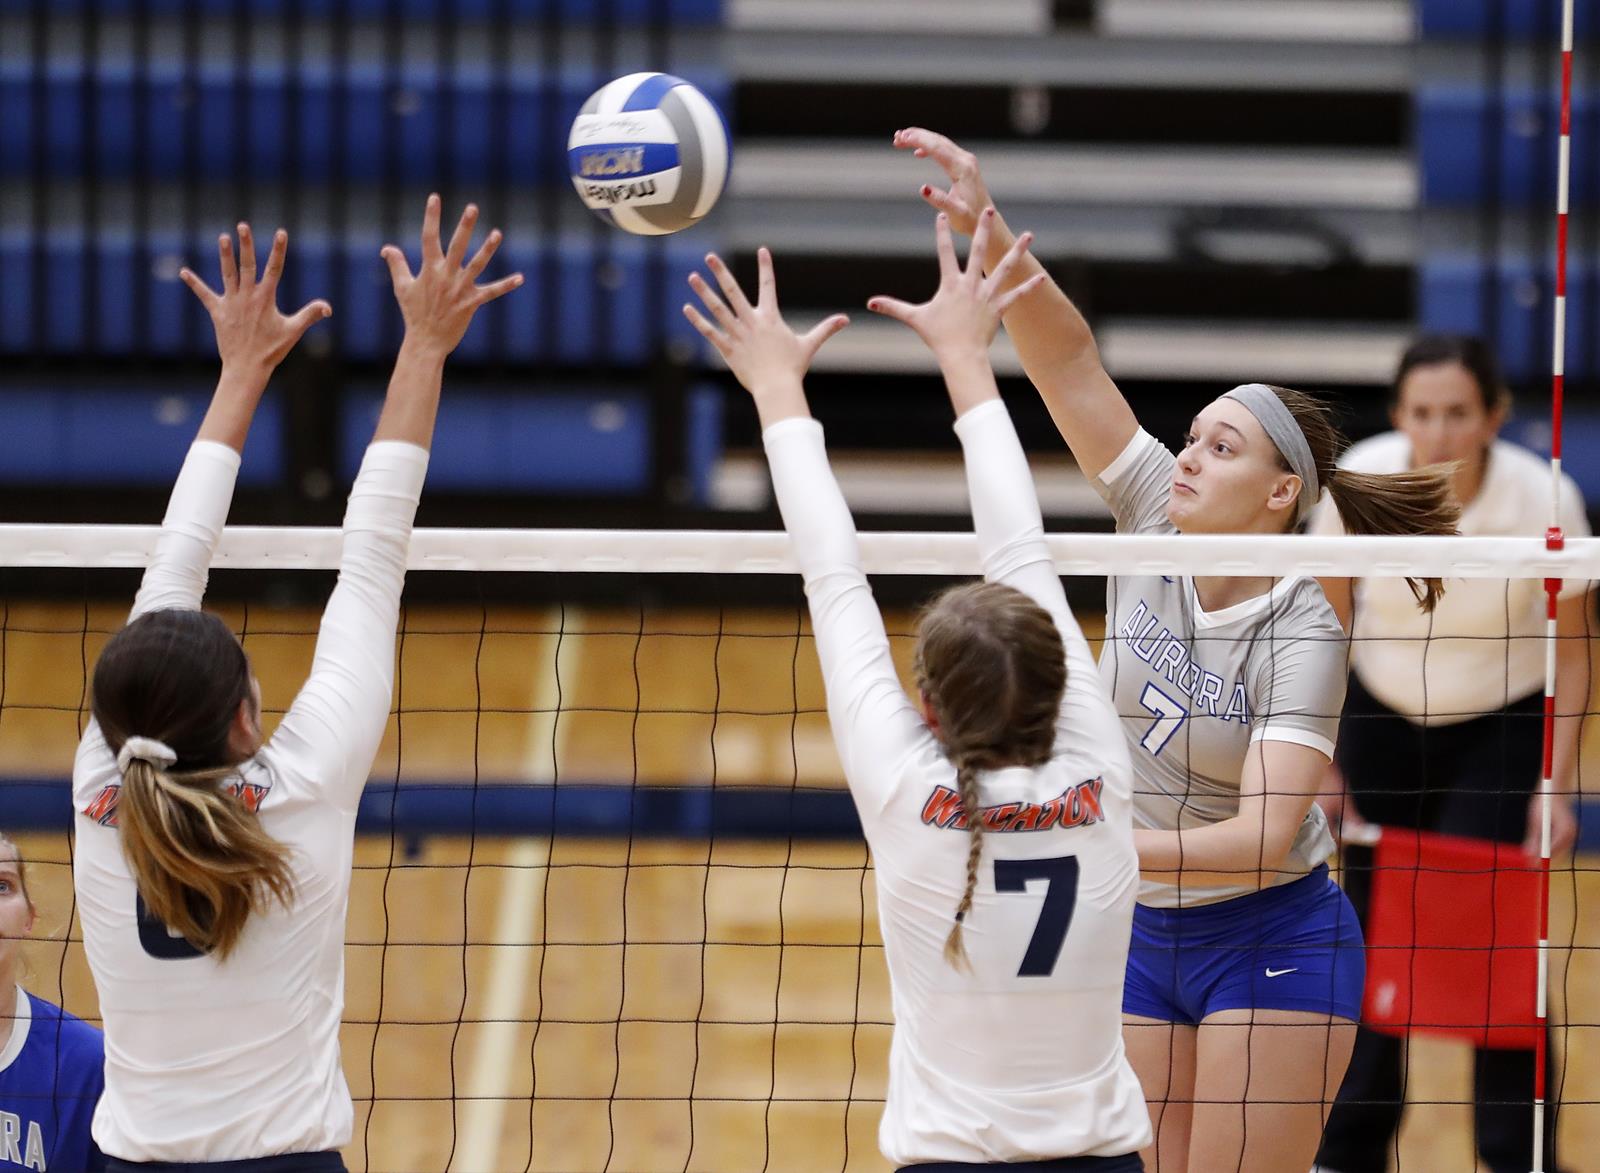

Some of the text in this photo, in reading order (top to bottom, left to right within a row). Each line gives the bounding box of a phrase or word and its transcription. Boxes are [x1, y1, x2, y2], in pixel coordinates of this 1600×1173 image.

[1121, 599, 1249, 725] AURORA
[1139, 680, 1189, 757] 7
[993, 855, 1080, 977] 7
